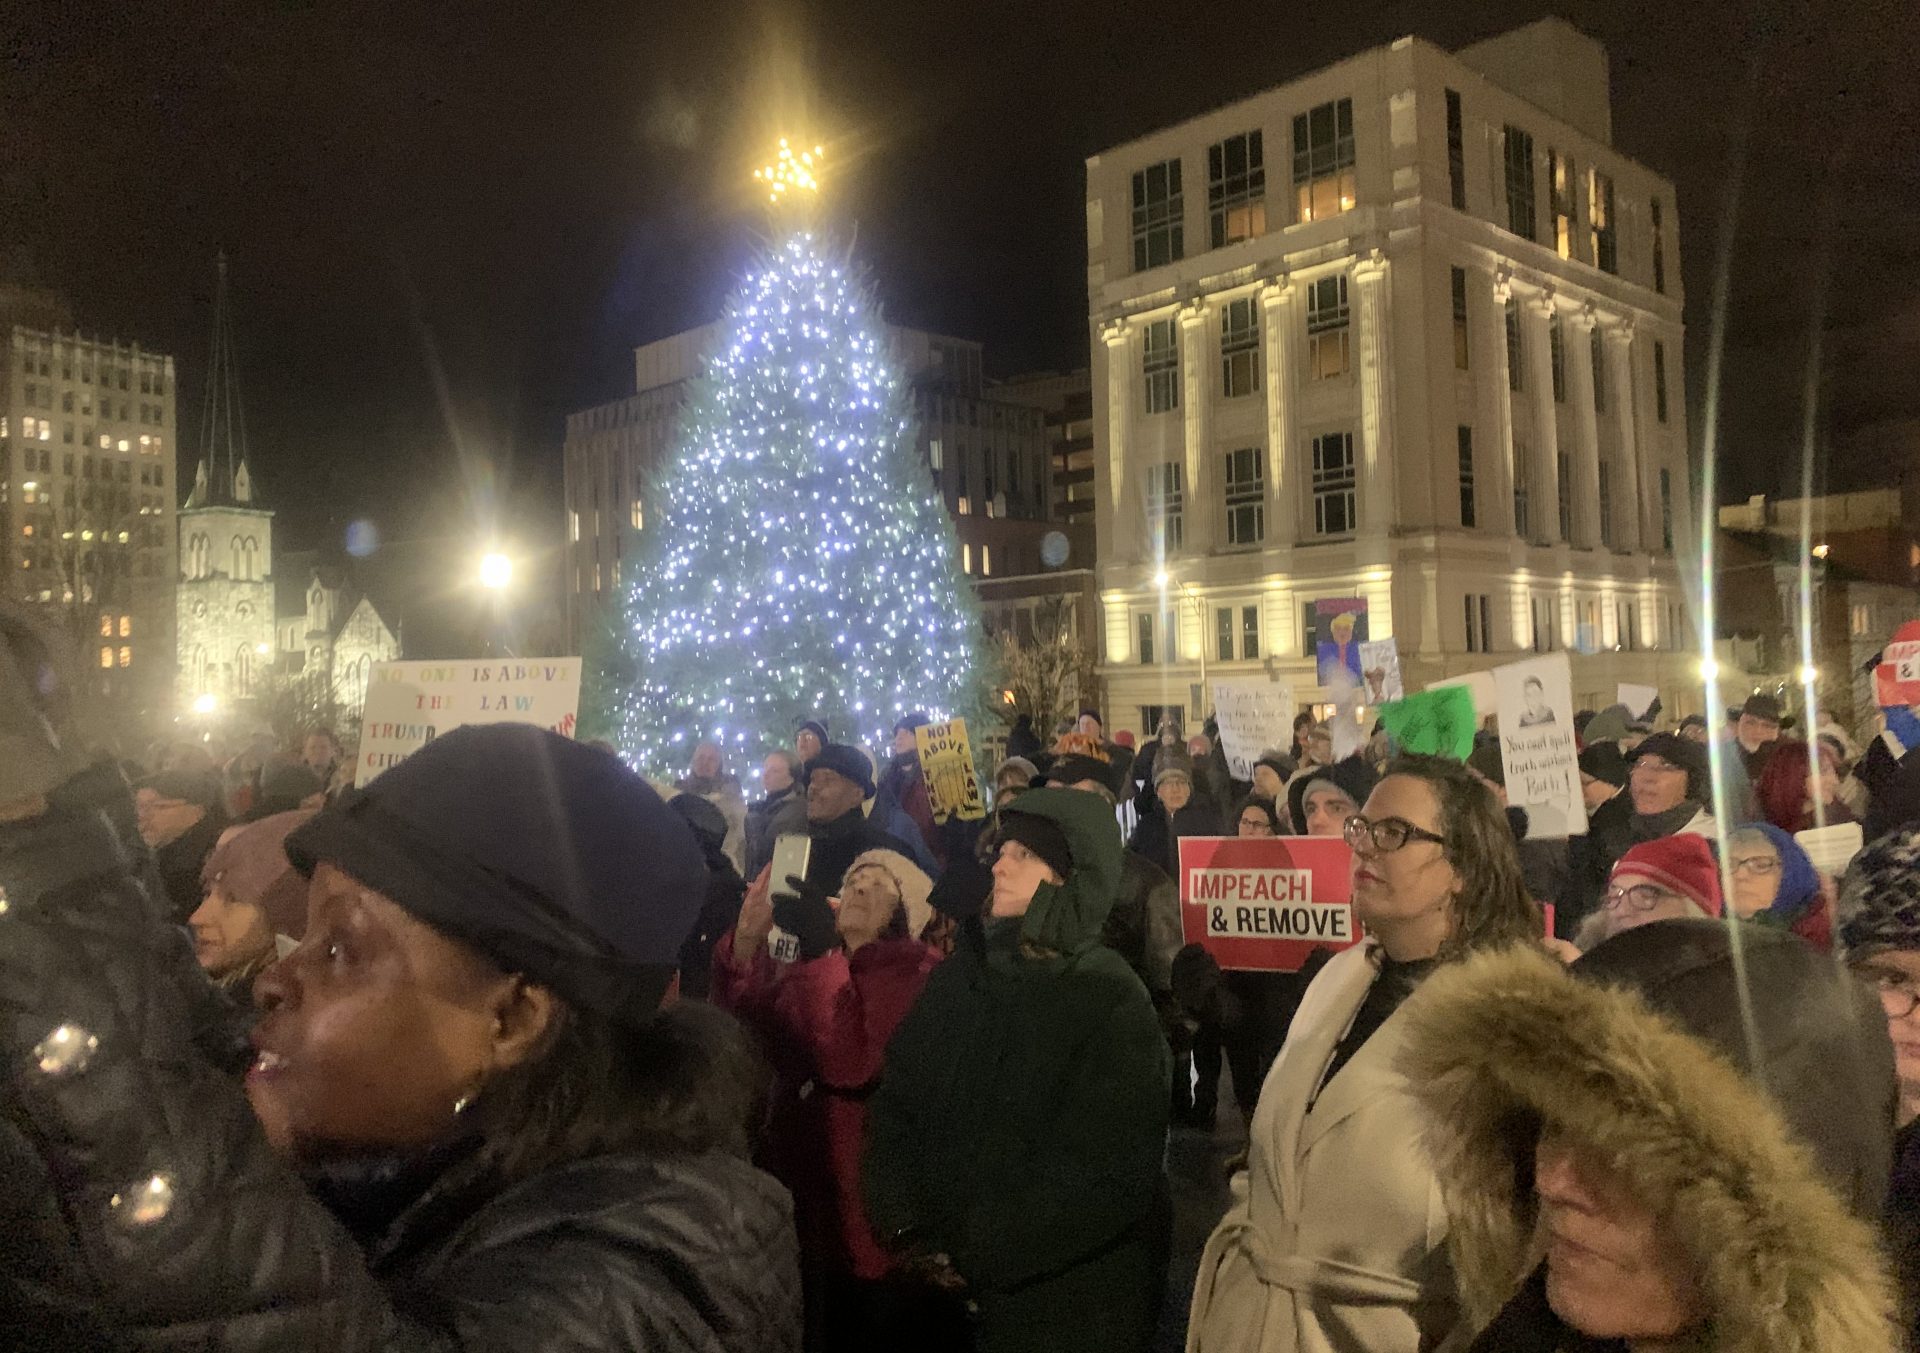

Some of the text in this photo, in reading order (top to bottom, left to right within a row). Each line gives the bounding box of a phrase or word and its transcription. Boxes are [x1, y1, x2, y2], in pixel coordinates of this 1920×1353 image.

[377, 665, 569, 682] NO ONE IS ABOVE
[416, 695, 534, 711] THE LAW
[369, 723, 436, 744] TRUMP
[927, 724, 951, 738] NOT
[924, 739, 964, 760] ABOVE
[1510, 757, 1537, 774] truth
[963, 762, 978, 801] LAW
[1193, 874, 1307, 902] IMPEACH
[1211, 905, 1346, 937] & REMOVE
